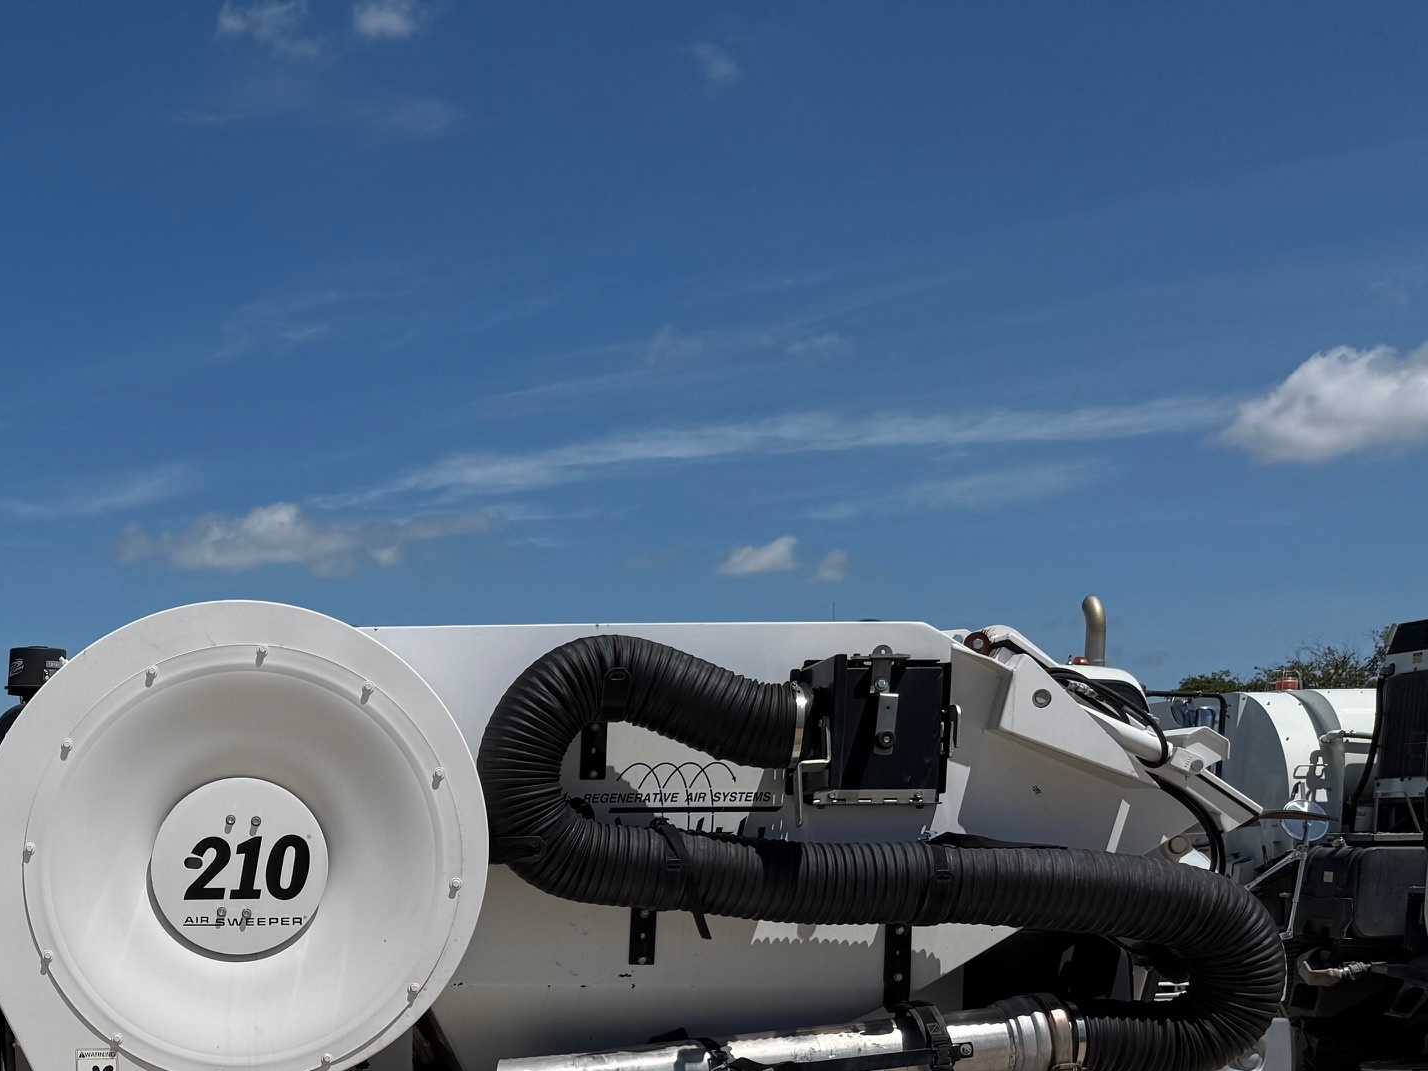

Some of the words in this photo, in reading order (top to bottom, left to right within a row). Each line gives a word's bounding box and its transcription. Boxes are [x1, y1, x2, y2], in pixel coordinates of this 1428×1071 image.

[583, 792, 679, 804] REGENERATIVE
[685, 792, 707, 803] AIR
[712, 791, 772, 802] SYSTEMS
[183, 834, 310, 900] 210
[184, 916, 209, 924] AIR
[215, 917, 303, 926] SWEEPER
